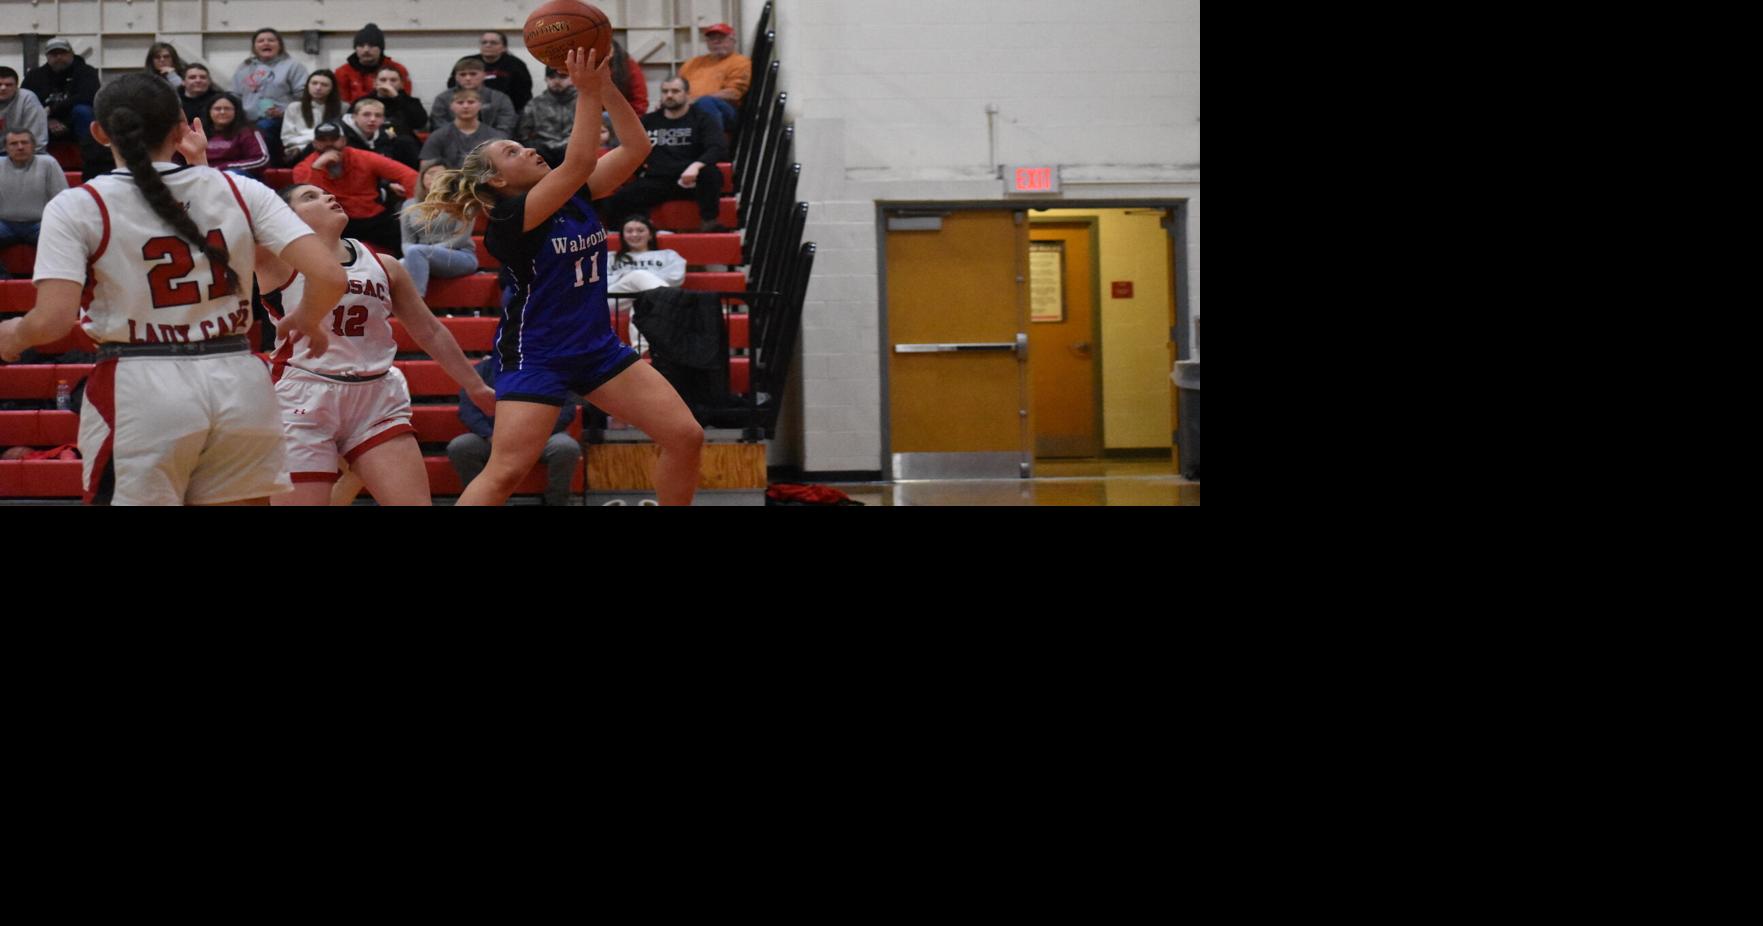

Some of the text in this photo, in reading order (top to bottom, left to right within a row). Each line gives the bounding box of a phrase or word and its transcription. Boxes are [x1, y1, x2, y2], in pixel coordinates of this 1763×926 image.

[1015, 167, 1052, 191] EXIT
[142, 228, 237, 309] 21
[574, 251, 600, 287] 11
[128, 319, 190, 344] LADY
[331, 305, 369, 337] 12
